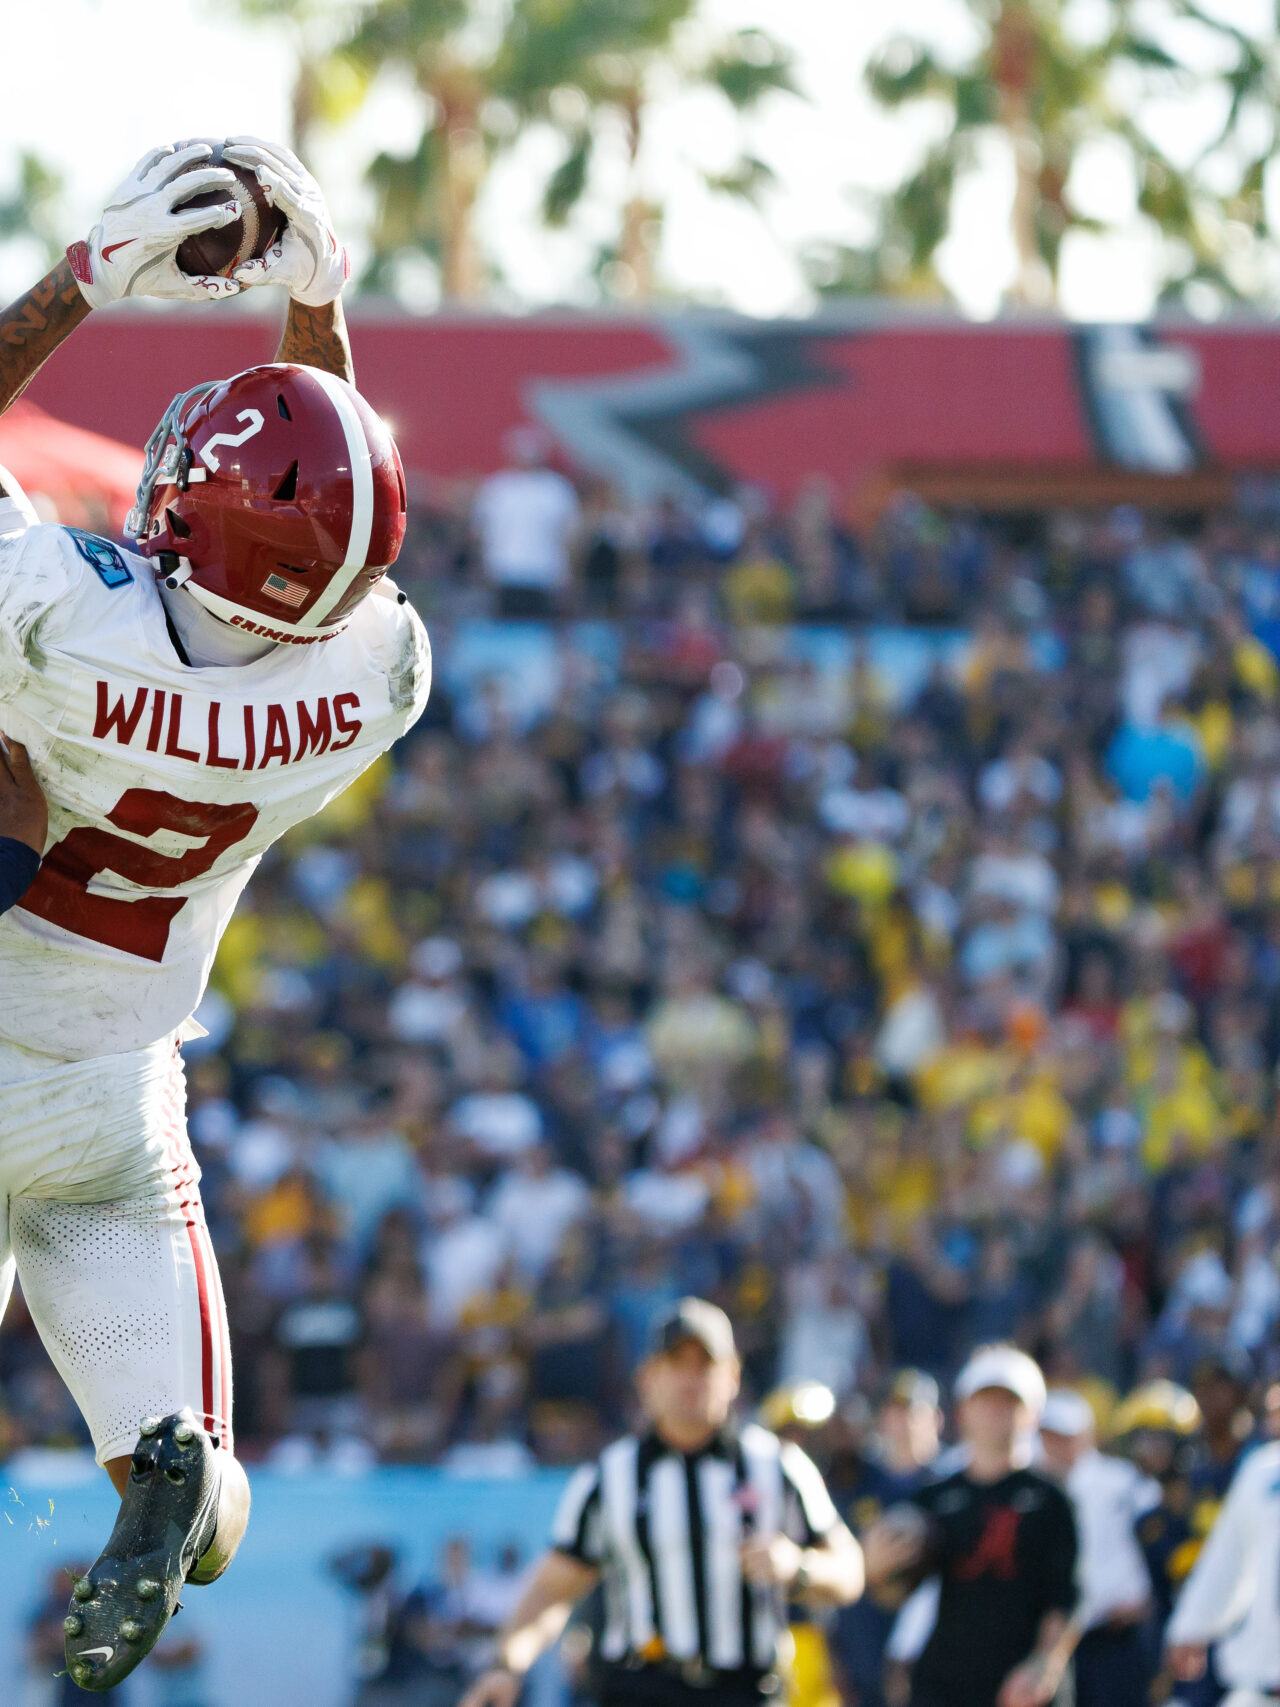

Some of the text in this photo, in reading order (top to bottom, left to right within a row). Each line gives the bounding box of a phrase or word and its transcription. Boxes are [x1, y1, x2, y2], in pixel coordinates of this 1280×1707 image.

[199, 408, 265, 474] 2
[229, 614, 318, 645] CRIMSON
[92, 680, 363, 771] WILLIAMS
[16, 788, 260, 963] 2
